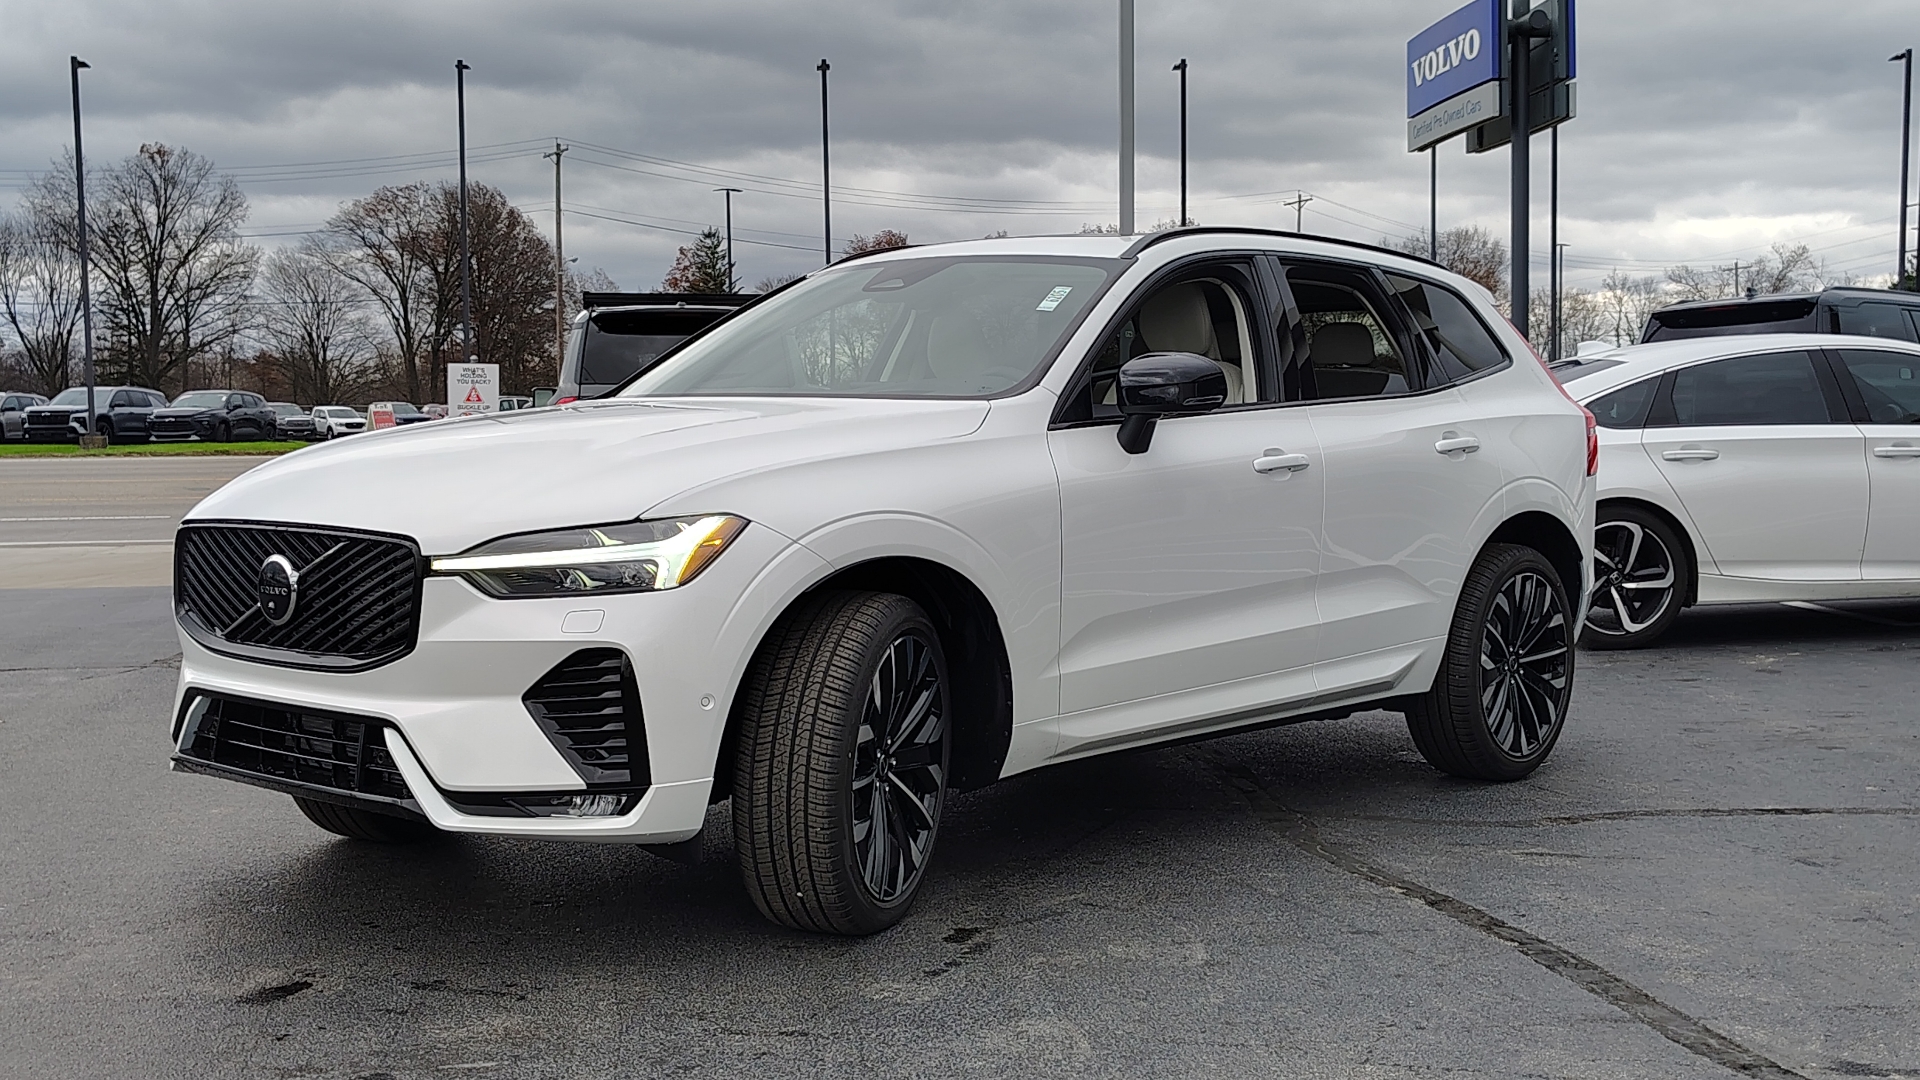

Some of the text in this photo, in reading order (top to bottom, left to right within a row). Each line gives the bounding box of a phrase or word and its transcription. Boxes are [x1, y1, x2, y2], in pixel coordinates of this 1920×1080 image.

[1411, 28, 1481, 87] VOLVO
[1412, 99, 1482, 139] Certified Pre Owned Cars
[260, 585, 288, 595] VOLVO
